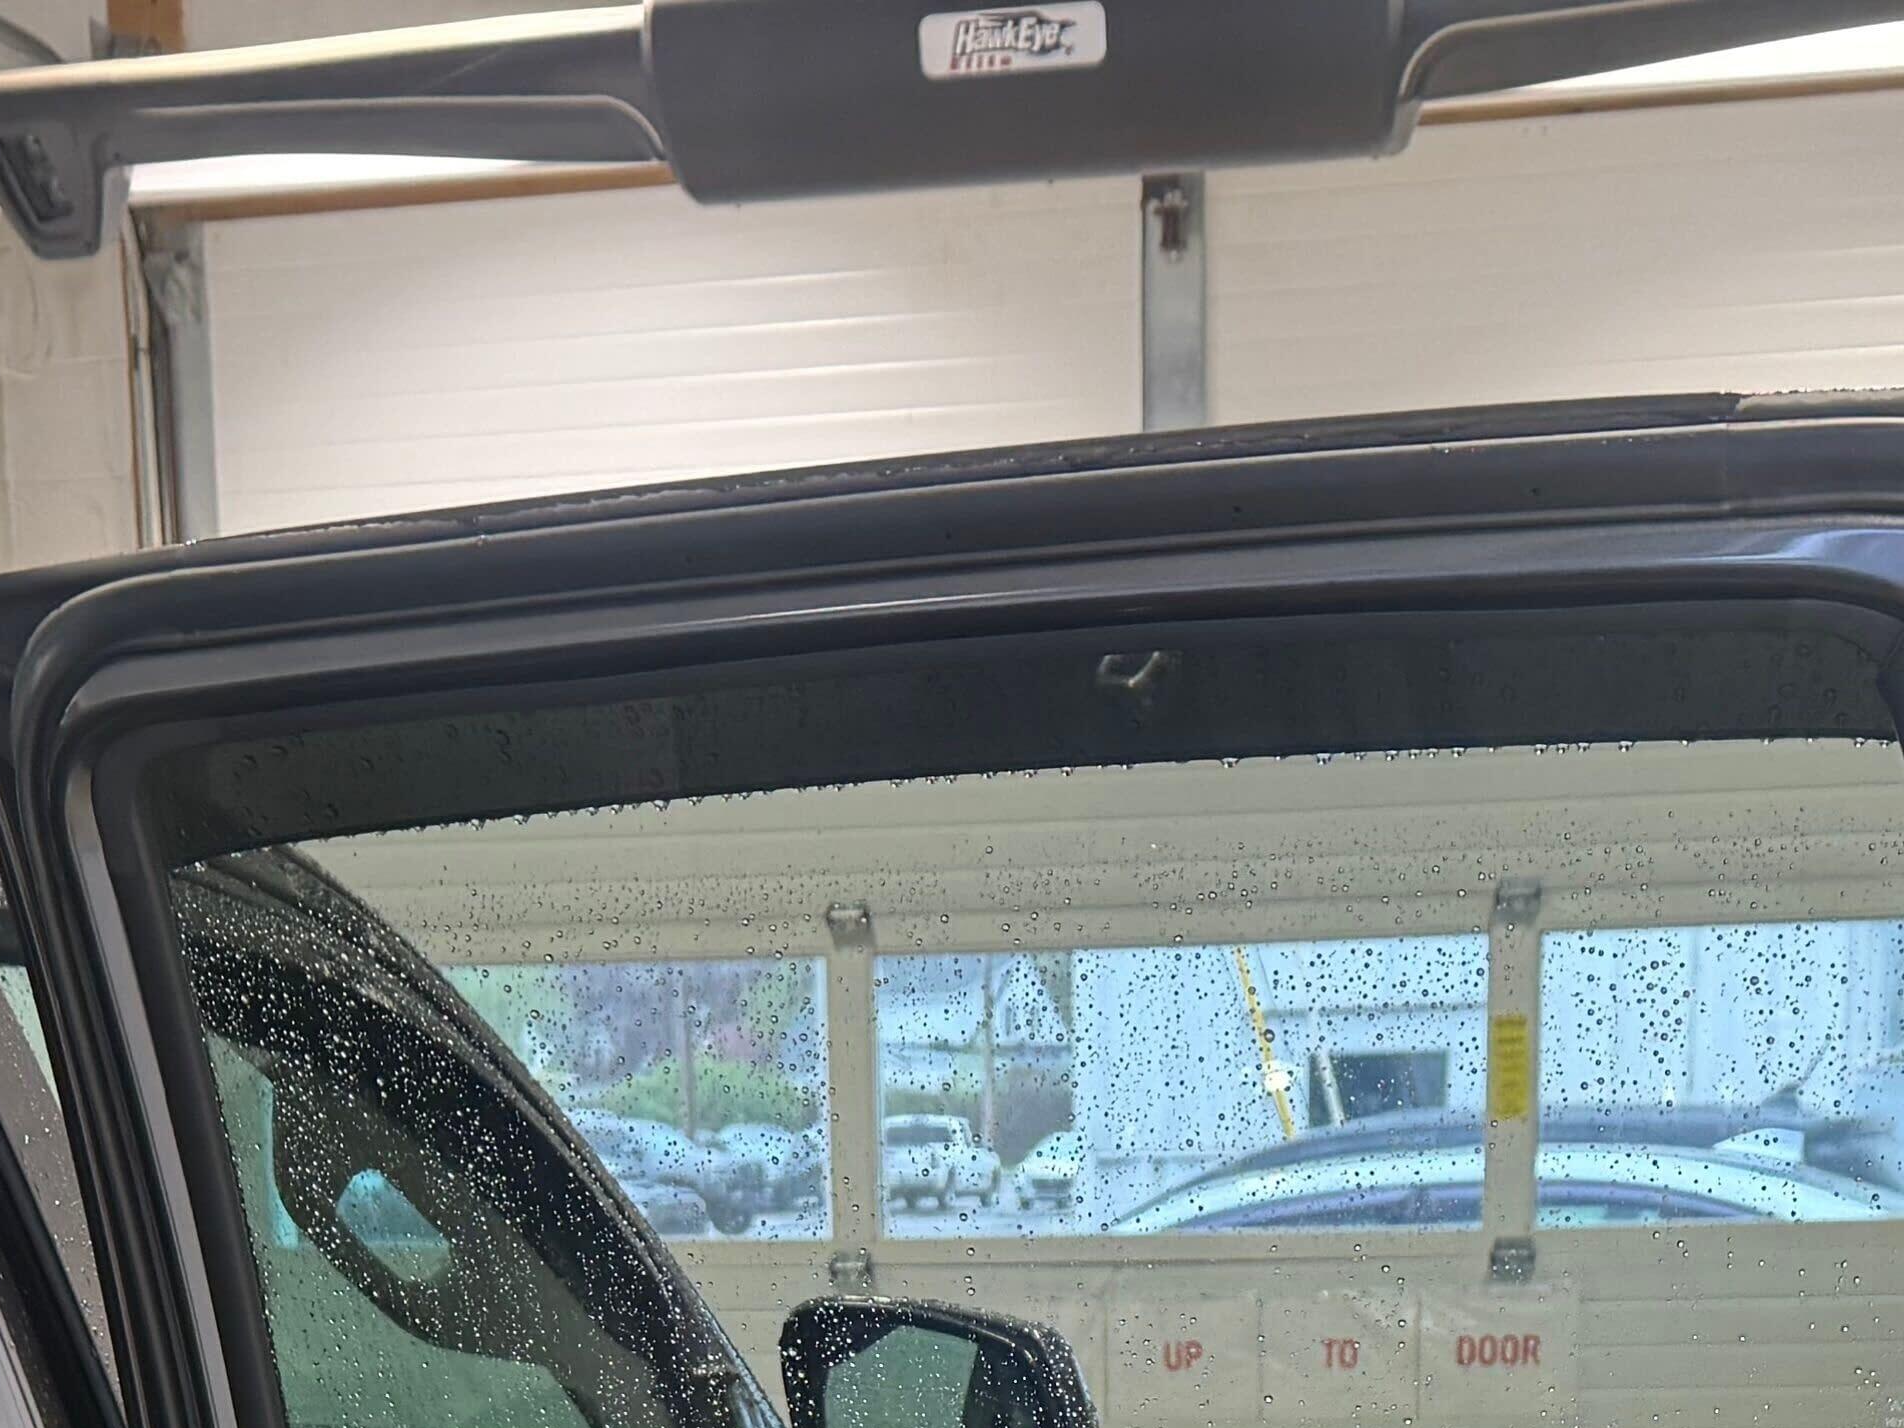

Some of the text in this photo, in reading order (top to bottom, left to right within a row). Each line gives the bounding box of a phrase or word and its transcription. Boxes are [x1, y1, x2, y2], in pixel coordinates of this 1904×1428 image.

[954, 16, 1062, 55] HawkEye
[1163, 1333, 1541, 1371] UP TO DOOR
